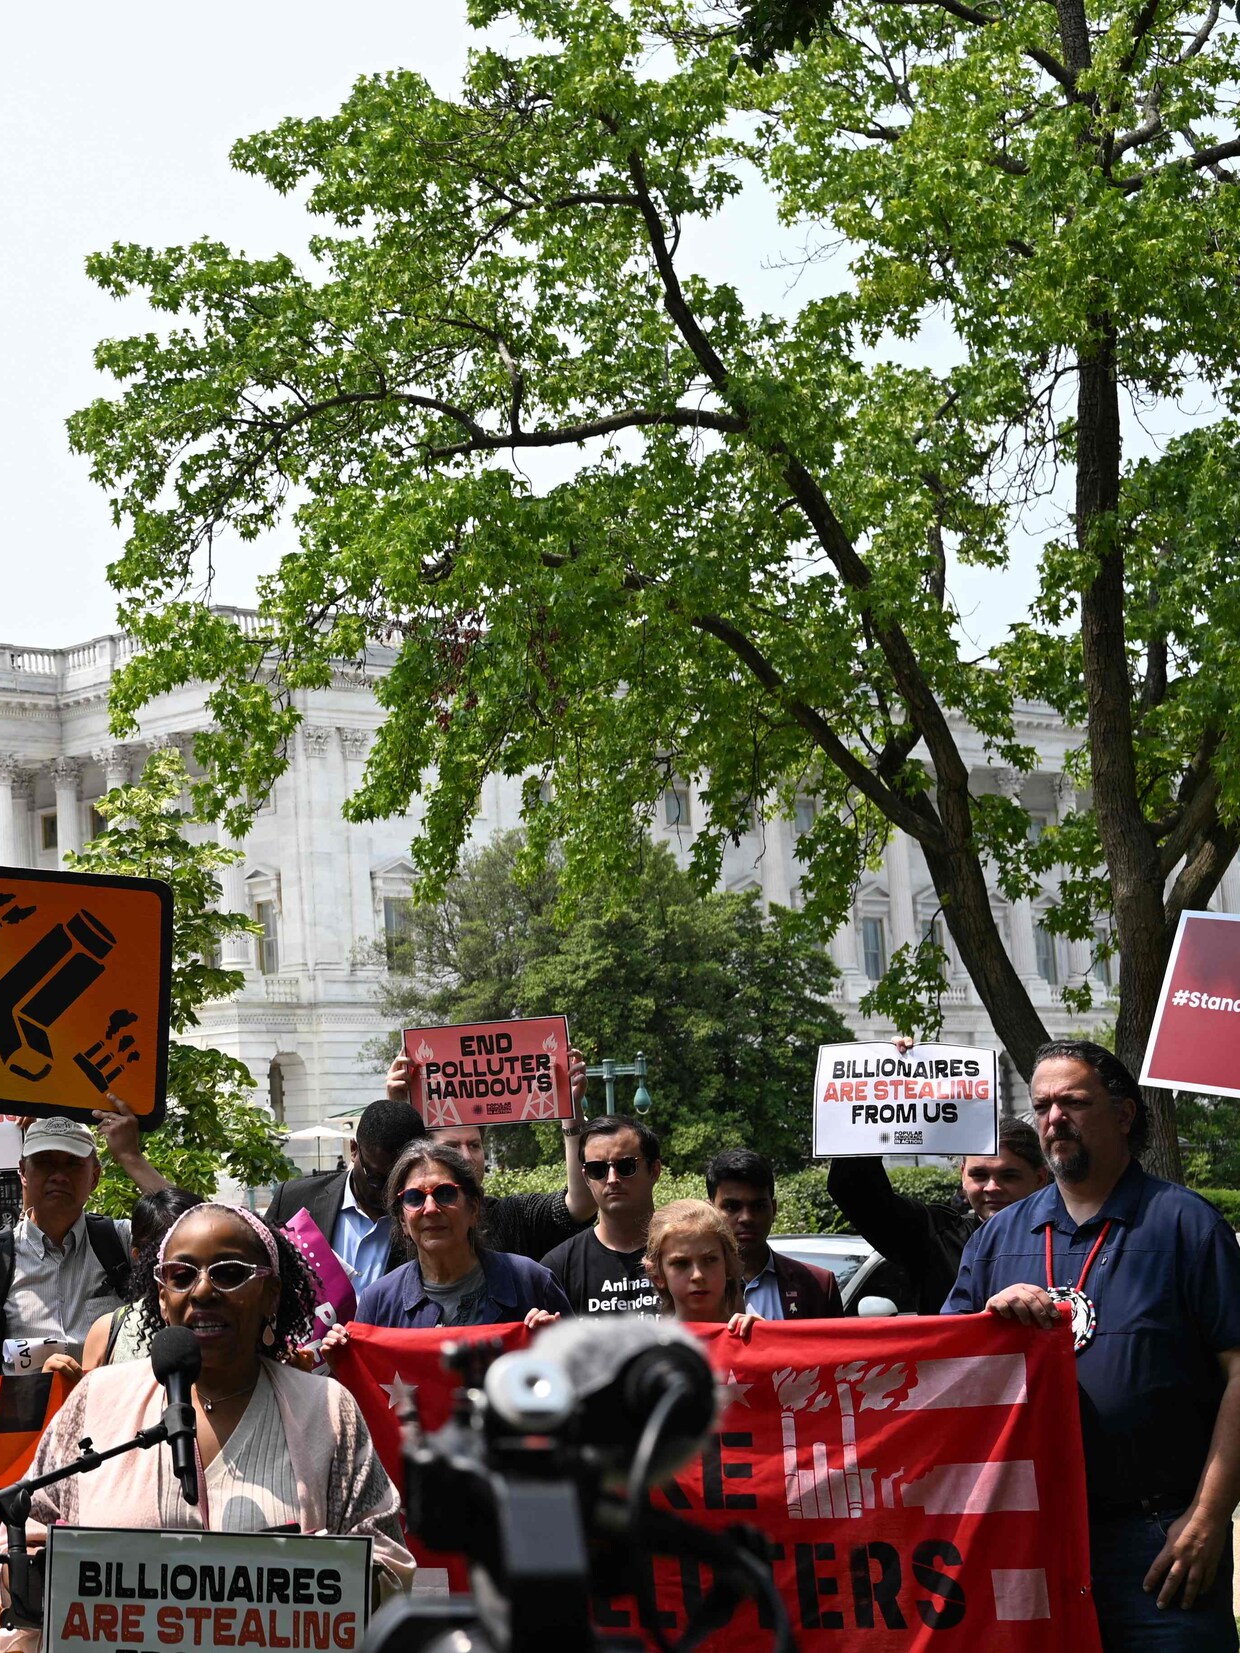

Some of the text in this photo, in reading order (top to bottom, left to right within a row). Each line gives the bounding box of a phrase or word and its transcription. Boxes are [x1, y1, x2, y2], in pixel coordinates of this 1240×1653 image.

[460, 1032, 513, 1057] END
[425, 1053, 551, 1080] POLLUTER
[832, 1058, 980, 1080] BILLIONAIRES
[427, 1073, 553, 1101] HANDOUTS
[823, 1079, 990, 1103] ARE STEALING
[851, 1102, 959, 1125] FROM US
[601, 1277, 654, 1293] Anima
[588, 1294, 662, 1312] Defender
[78, 1560, 342, 1605] BILLIONAIRES
[60, 1602, 357, 1650] ARE STEALING
